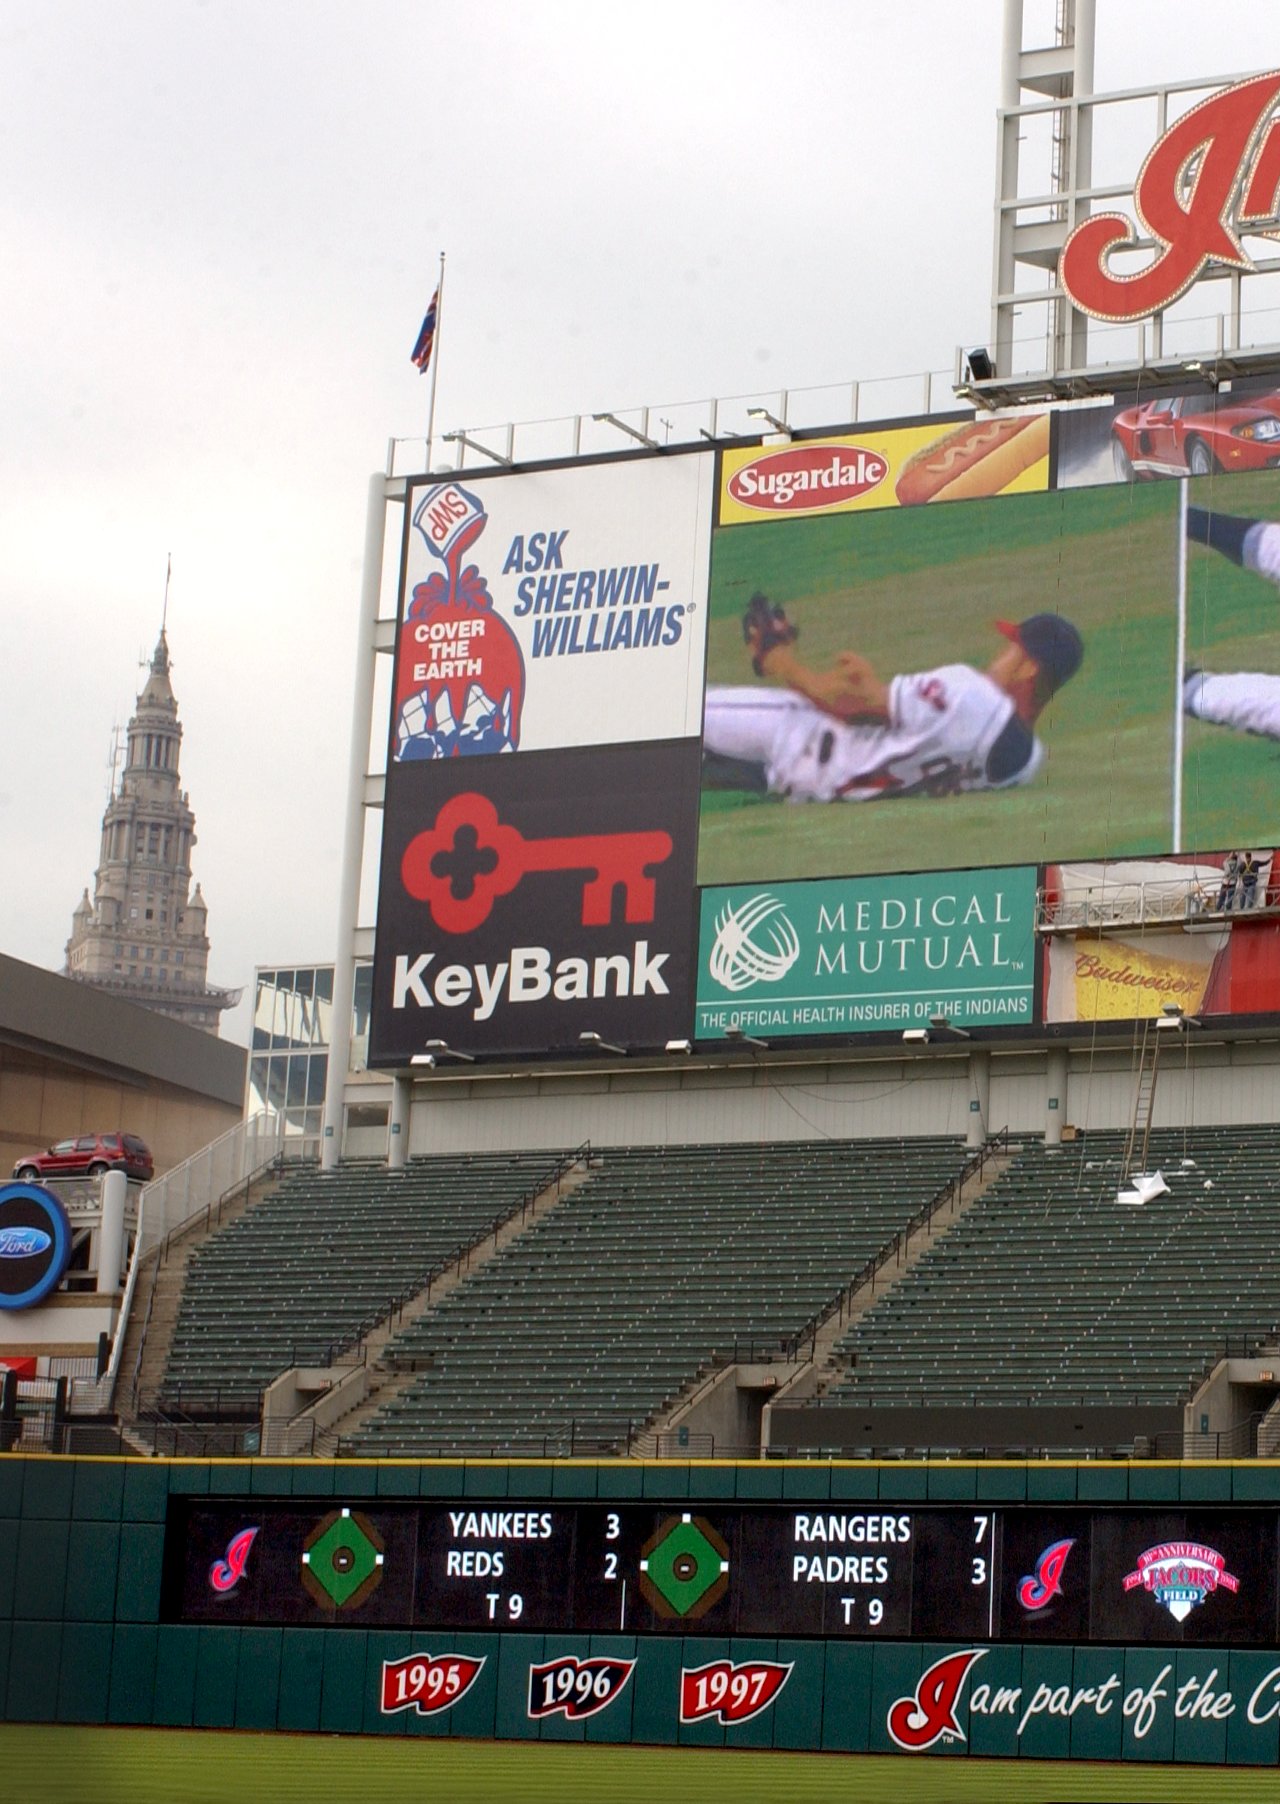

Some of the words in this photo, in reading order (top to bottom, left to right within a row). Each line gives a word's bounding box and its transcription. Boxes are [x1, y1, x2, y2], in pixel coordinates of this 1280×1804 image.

[737, 454, 881, 504] Sugardale
[427, 490, 469, 542] SWP
[502, 530, 569, 575] ASK
[514, 563, 670, 617] SHERWIN-
[414, 619, 486, 643] COVER
[532, 604, 685, 658] WILLIAMS
[429, 640, 470, 660] THE
[413, 659, 482, 682] EARTH
[816, 892, 1011, 934] MEDICAL
[815, 932, 1010, 976] MUTUAL
[392, 941, 670, 1022] KeyBank
[1075, 953, 1200, 995] Budweiser
[702, 1012, 727, 1029] THE
[731, 1008, 788, 1026] OFFICIAL
[793, 1006, 845, 1025] HEALTH
[849, 1002, 910, 1022] INSURER
[915, 1001, 932, 1018] OF
[935, 1000, 962, 1017] THE
[966, 997, 1028, 1016] INDIANS
[0, 1231, 38, 1253] Ford
[448, 1511, 552, 1539] YANKEES
[606, 1514, 621, 1540] 3
[793, 1515, 911, 1544] RANGERS
[973, 1516, 988, 1544] 7
[446, 1550, 504, 1578] REDS
[604, 1553, 617, 1579] 2
[792, 1556, 888, 1584] PADRES
[971, 1558, 986, 1585] 3
[1144, 1566, 1217, 1592] JACOBS
[486, 1594, 498, 1620] T
[509, 1594, 524, 1620] 9
[841, 1598, 854, 1626] T
[868, 1598, 883, 1626] 9
[1163, 1590, 1199, 1601] FIELD
[395, 1663, 462, 1699] 1995
[543, 1663, 611, 1703] 1996
[695, 1670, 768, 1711] 1997
[970, 1682, 1017, 1714] am
[1016, 1672, 1121, 1735] part
[1123, 1664, 1172, 1738] of
[1175, 1665, 1236, 1720] the
